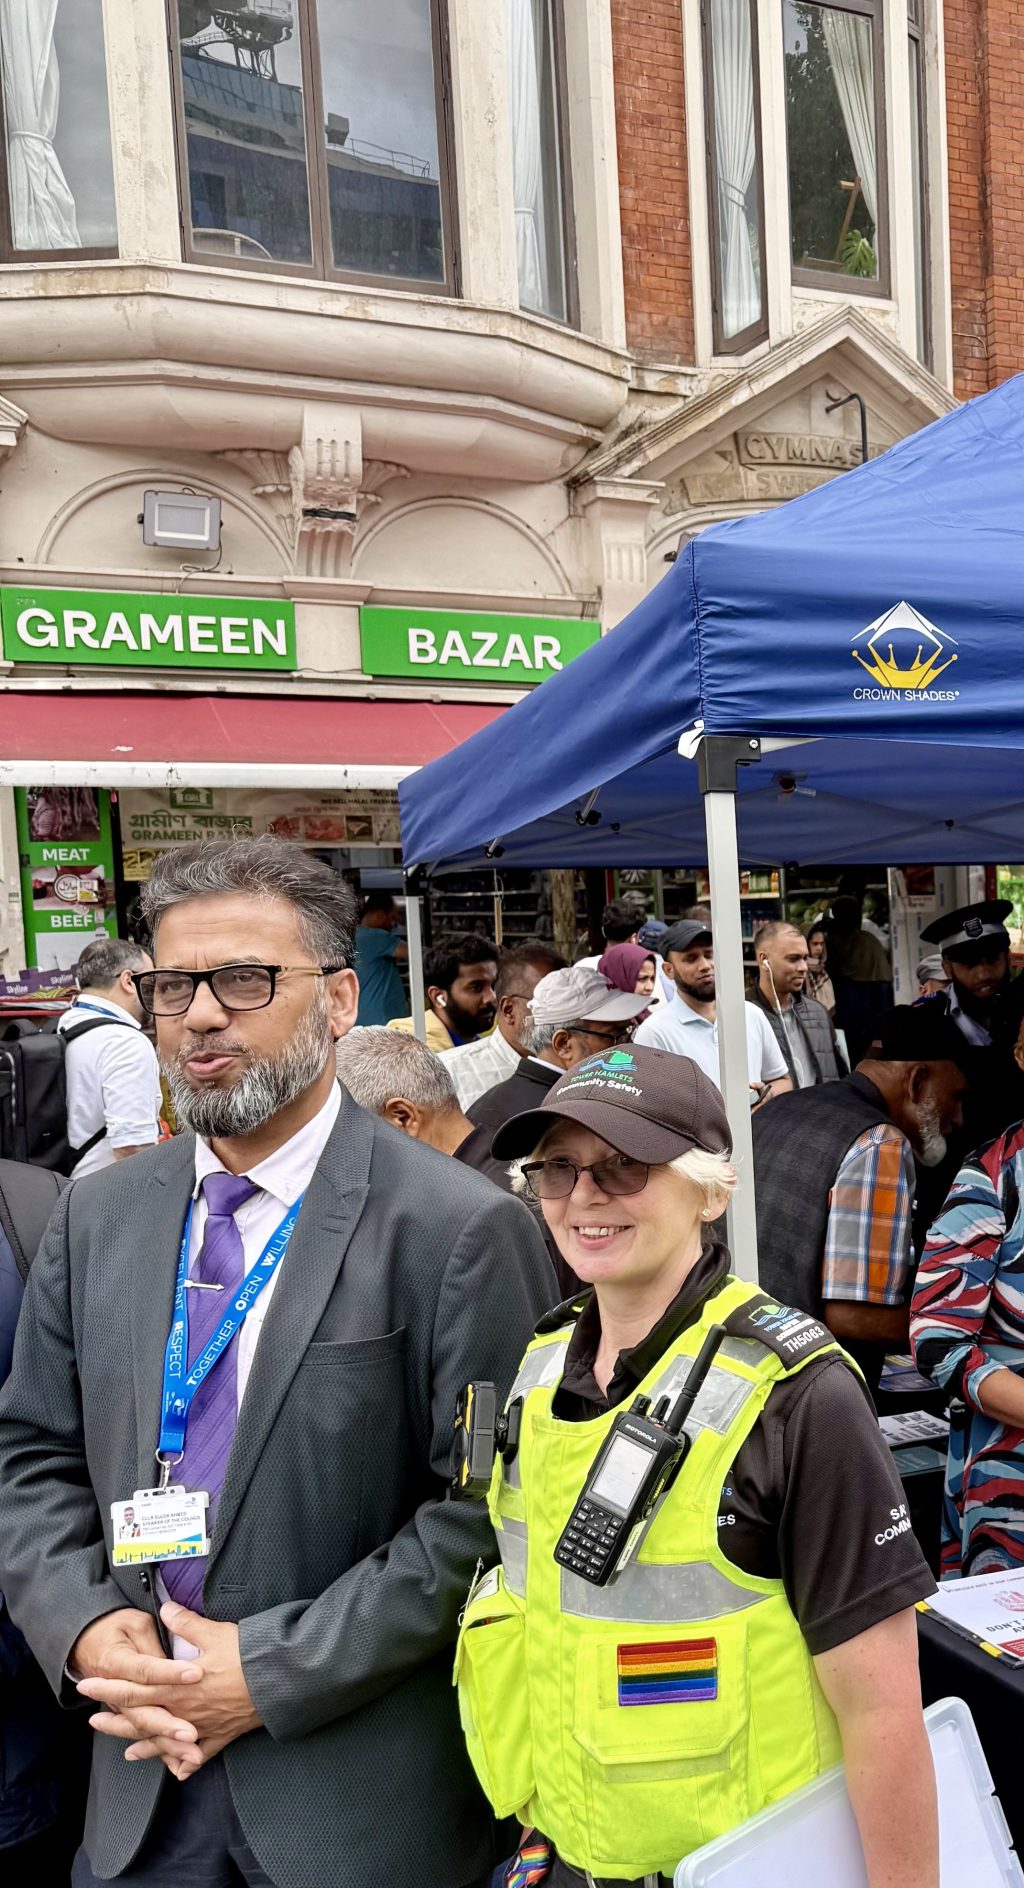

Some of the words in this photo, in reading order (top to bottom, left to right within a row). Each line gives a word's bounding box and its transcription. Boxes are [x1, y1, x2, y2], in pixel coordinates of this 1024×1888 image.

[16, 608, 288, 656] GRAMEEN
[407, 627, 563, 671] BAZAR
[853, 688, 900, 700] CROWN
[132, 829, 200, 841] GRAMEEN
[43, 848, 91, 861] MEAT
[51, 914, 93, 928] BEEF
[595, 1069, 634, 1083] HAMLETS
[607, 1079, 643, 1096] Safety
[235, 1275, 263, 1311] OPEN
[169, 1321, 184, 1378] RESPECT
[186, 1319, 236, 1386] TOGETHER
[625, 1423, 658, 1444] MOTOROLA
[986, 1619, 1021, 1633] DON'T
